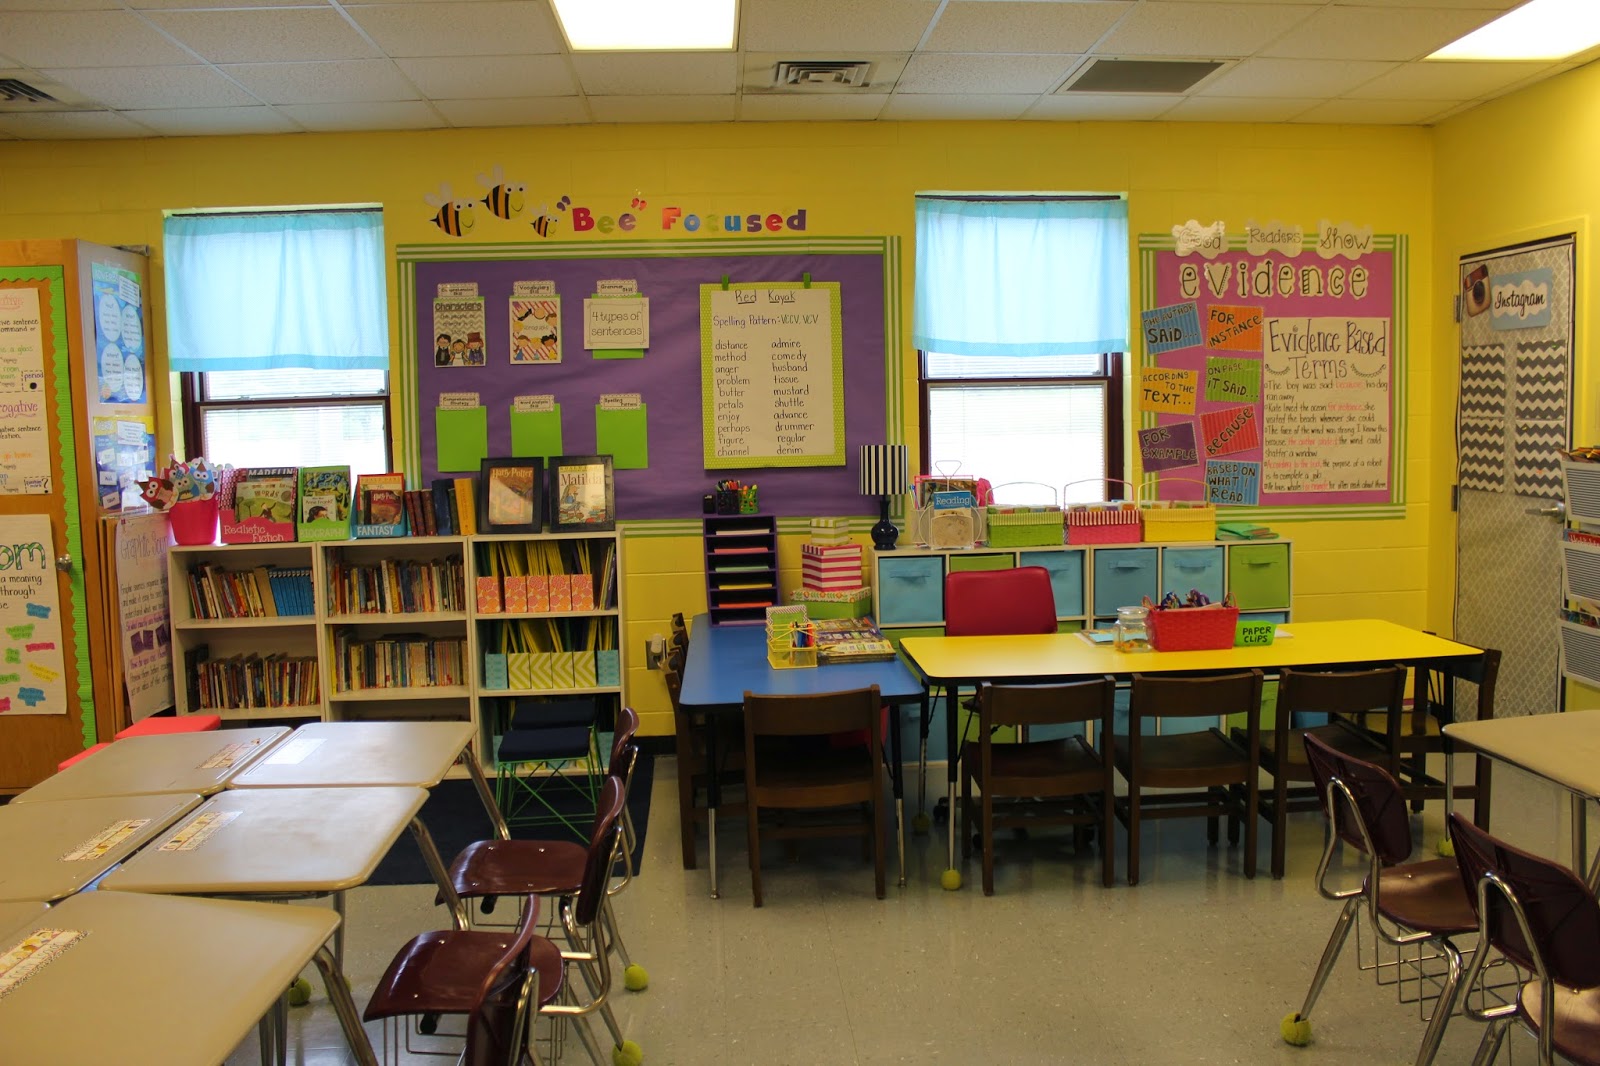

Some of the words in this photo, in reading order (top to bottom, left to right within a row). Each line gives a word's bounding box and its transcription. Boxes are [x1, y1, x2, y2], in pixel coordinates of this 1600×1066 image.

[661, 207, 806, 233] Focused
[735, 290, 757, 303] Red
[768, 290, 795, 304] Kayak
[1494, 290, 1545, 317] Instagram
[13, 318, 39, 326] sentence
[592, 312, 598, 321] 4
[600, 313, 628, 324] types
[630, 311, 641, 321] of
[713, 316, 745, 328] Spelling
[1211, 309, 1235, 326] FOR
[591, 327, 642, 337] sentences
[1269, 319, 1341, 354] Evidence
[1346, 320, 1386, 356] Based
[715, 340, 748, 350] distance
[772, 338, 801, 348] admire
[715, 352, 747, 362] method
[772, 350, 807, 362] comedy
[715, 366, 739, 376] anger
[772, 362, 808, 371] husband
[1208, 366, 1221, 376] ON
[1288, 355, 1347, 379] Terms
[24, 372, 44, 382] period
[716, 377, 750, 388] problem
[774, 375, 799, 384] tissue
[774, 385, 809, 396] mustard
[1165, 381, 1176, 390] TO
[1267, 380, 1282, 390] The
[1286, 379, 1299, 392] boy
[1319, 379, 1333, 389] sad
[1376, 379, 1387, 392] dog
[719, 388, 745, 397] butter
[718, 400, 744, 411] petals
[774, 398, 804, 408] shuttle
[1268, 403, 1281, 412] Kate
[1283, 402, 1298, 412] loved
[1300, 401, 1308, 411] the
[717, 412, 740, 423] enjoy
[773, 410, 808, 420] advance
[1266, 413, 1286, 423] visited
[1287, 413, 1297, 423] the
[1300, 413, 1316, 423] beach
[1358, 413, 1375, 422] could
[717, 424, 750, 436] perhaps
[775, 422, 815, 431] drummer
[1301, 425, 1310, 434] the
[719, 434, 744, 446] figure
[777, 433, 806, 445] regular
[1143, 428, 1171, 447] FOR
[717, 446, 750, 456] channel
[776, 444, 803, 455] denim
[492, 469, 511, 479] Harry
[511, 467, 533, 478] Potter
[1241, 466, 1256, 477] ON
[561, 473, 602, 486] Matilda
[1208, 476, 1239, 486] WHAT
[936, 496, 970, 506] Reading
[224, 524, 266, 535] Realistic
[357, 525, 395, 535] FANTASY
[252, 533, 284, 543] Fiction
[9, 575, 42, 585] meaning
